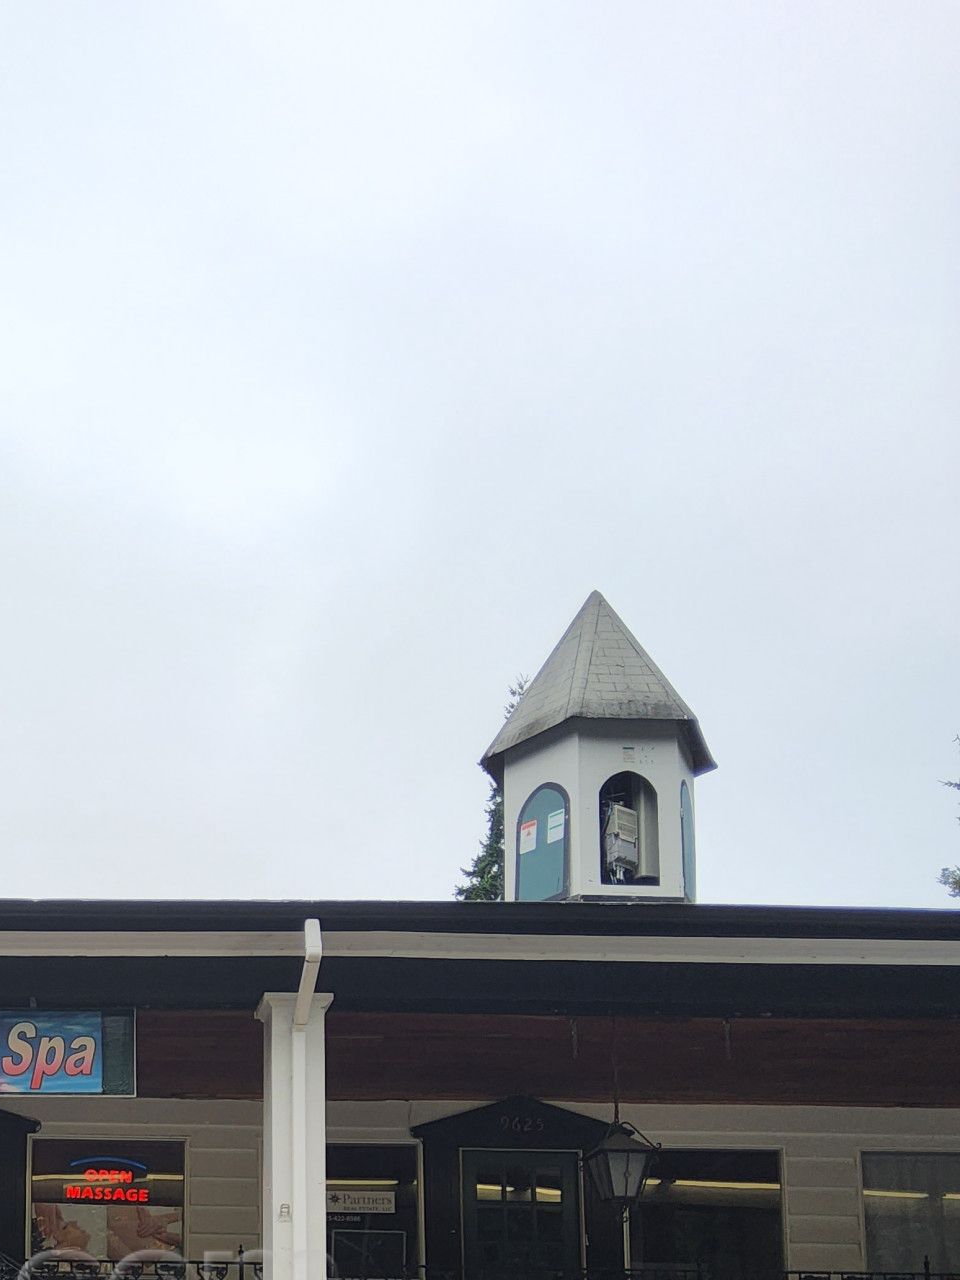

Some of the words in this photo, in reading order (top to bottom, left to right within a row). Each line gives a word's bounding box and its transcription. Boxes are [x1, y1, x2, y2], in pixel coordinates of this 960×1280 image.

[1, 1021, 96, 1090] Spa
[84, 1169, 133, 1183] OPEN
[66, 1185, 149, 1202] MASSAGE
[343, 1193, 392, 1205] Partners
